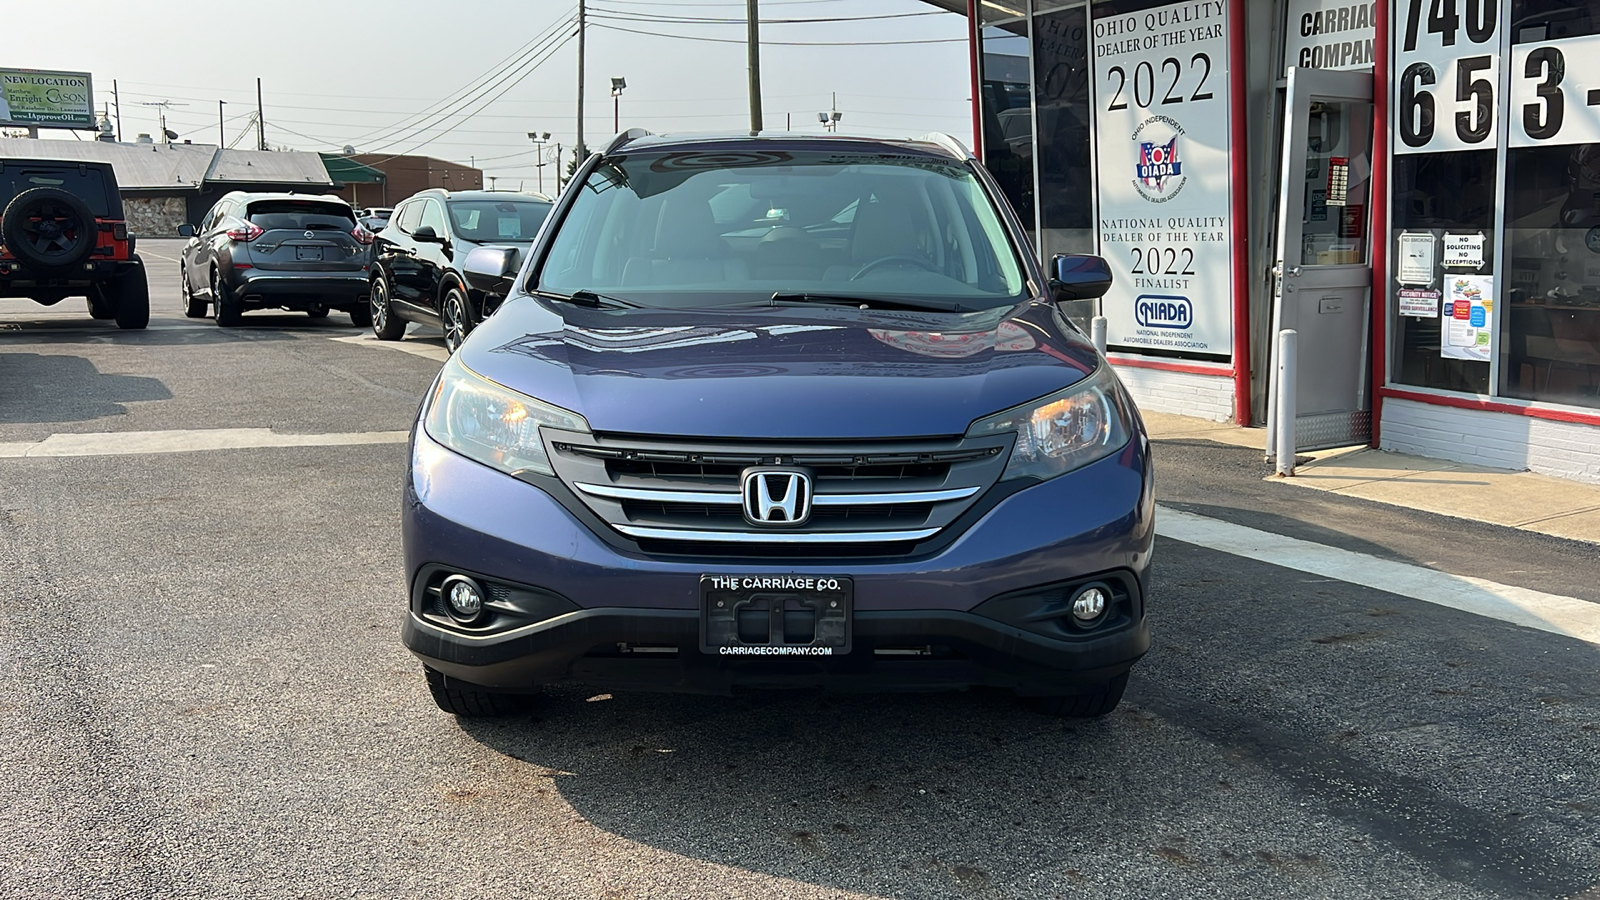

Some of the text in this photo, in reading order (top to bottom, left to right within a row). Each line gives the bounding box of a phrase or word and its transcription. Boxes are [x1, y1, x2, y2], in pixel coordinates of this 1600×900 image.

[1095, 0, 1225, 39] OHIO QUALITY
[1097, 23, 1223, 58] DEALER OF THE YEAR
[4, 75, 85, 87] NEW LOCATION
[1107, 52, 1214, 111] 2022
[10, 95, 42, 104] Enright
[1131, 115, 1186, 141] OHIO INDEPENDENT
[1141, 163, 1174, 177] OIADA
[1131, 179, 1151, 202] AUTOMOBILE
[1102, 217, 1226, 230] NATIONAL QUALITY
[1103, 232, 1224, 242] DEALER OF THE YEAR
[1130, 247, 1195, 276] 2022
[1135, 278, 1190, 289] FINALIST
[1139, 302, 1187, 323] NIADA
[1136, 329, 1193, 339] NATIONAL INDEPENDENT
[1123, 336, 1208, 349] AUTOMOBILE DEALERS ASSOCIATION
[711, 577, 841, 591] THE CARRIAGE CO.
[719, 646, 833, 656] CARRIAGECOMPANY.COM
